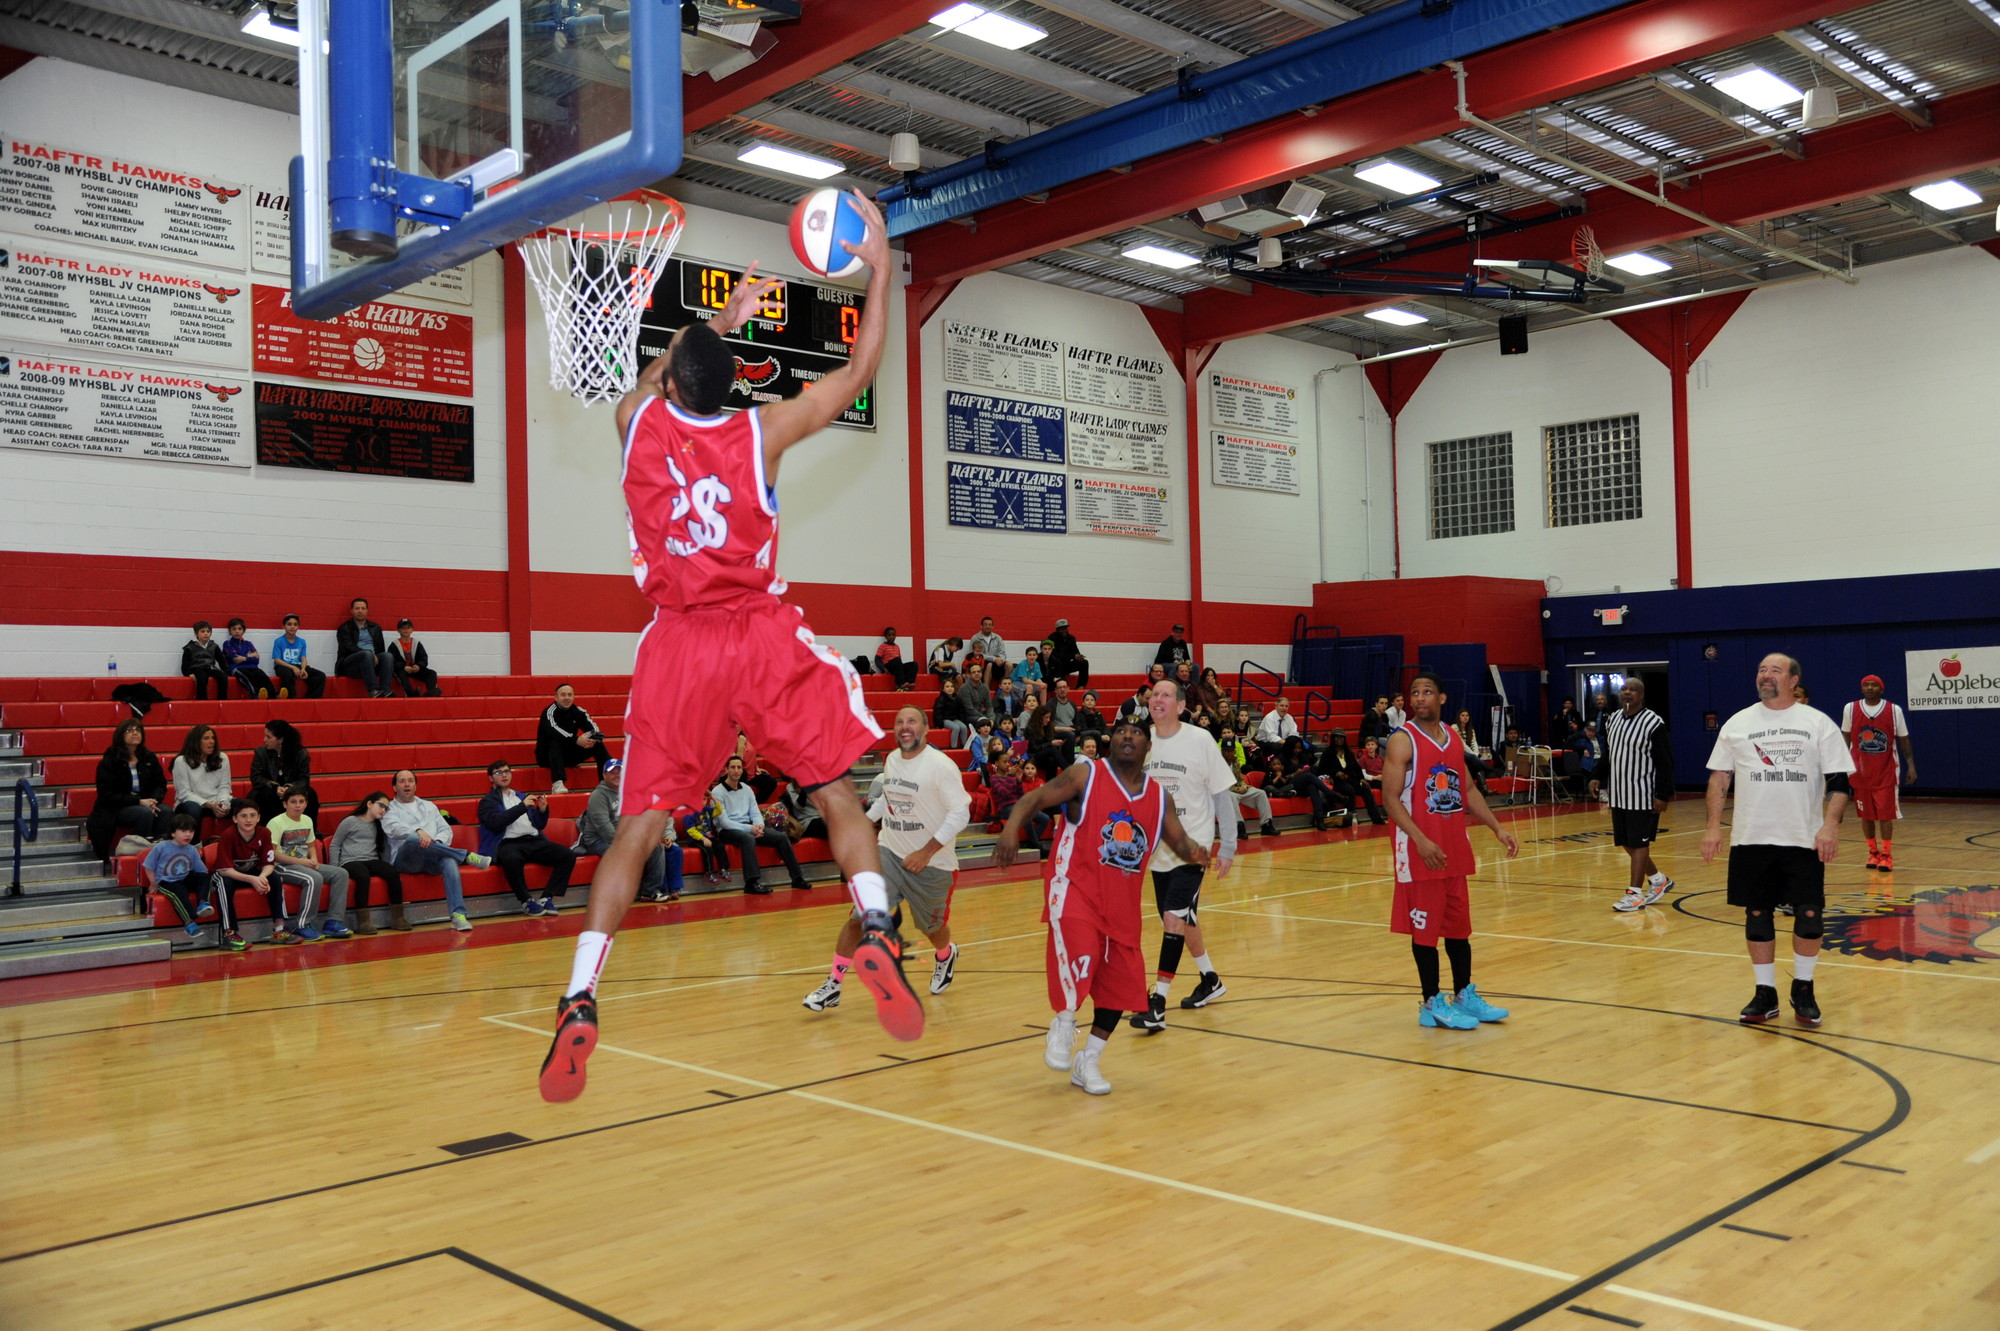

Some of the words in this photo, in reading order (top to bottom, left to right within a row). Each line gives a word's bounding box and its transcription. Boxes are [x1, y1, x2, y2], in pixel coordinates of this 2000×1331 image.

[12, 142, 102, 169] HAFTR
[112, 161, 202, 189] HAWKS
[12, 155, 60, 173] 2007-08
[64, 165, 113, 183] MYHSBL
[117, 176, 131, 186] JV
[135, 179, 201, 200] CHAMPIONS
[80, 183, 104, 193] DOVIE
[106, 188, 138, 199] GROSSER
[81, 192, 109, 202] SHAWN
[111, 197, 137, 207] ISRAELI
[86, 201, 105, 211] YONI
[107, 205, 132, 215] KAMEL
[164, 207, 190, 217] SHELBY
[191, 212, 231, 225] ROSENBERG
[174, 201, 199, 210] SAMMY
[200, 206, 222, 215] MYERS
[74, 208, 93, 217] YONI
[95, 212, 144, 226] KESTENBAUM
[170, 217, 201, 228] MICHAEL
[203, 223, 225, 232] SCHIFF
[82, 218, 99, 227] MAX
[101, 222, 136, 233] KURITZKY
[168, 225, 189, 234] ADAM
[191, 229, 227, 241] SCHWARTZ
[34, 223, 72, 235] COACHES:
[74, 230, 107, 241] MICHAEL
[138, 241, 158, 249] EVAN
[160, 244, 198, 256] SCHARAGA
[160, 233, 199, 244] JONATHAN
[200, 239, 235, 250] SHAMAMA
[16, 252, 79, 270] HAFTR
[86, 263, 132, 277] LADY
[139, 271, 202, 289] HAWKS
[17, 264, 63, 280] 2007-08
[67, 272, 115, 288] MYHSBL
[119, 280, 133, 290] JV
[136, 283, 201, 300] CHAMPIONS
[89, 289, 126, 300] DANIELLA
[127, 295, 150, 303] LAZAR
[817, 288, 854, 306] GUESTS
[173, 302, 206, 312] DANIELLE
[208, 307, 231, 315] MILLER
[696, 311, 712, 320] POSS
[170, 310, 202, 319] JORDANA
[204, 314, 234, 324] POLLACK
[366, 304, 448, 331] HAWKS
[347, 320, 370, 331] 2001
[372, 323, 420, 337] CHAMPIONS
[759, 322, 774, 331] POSS
[60, 327, 81, 335] HEAD
[83, 330, 111, 339] COACH:
[113, 334, 135, 343] RENEE
[137, 338, 179, 348] GREENSPAN
[979, 341, 994, 349] 2003
[1004, 332, 1059, 352] FLAMES
[68, 337, 104, 346] ASSISTANT
[106, 341, 133, 350] COACH:
[135, 345, 153, 353] TARA
[155, 348, 172, 356] RATZ
[824, 342, 848, 354] BONUS
[1068, 347, 1112, 365] HAFTR
[1117, 355, 1164, 374] FLAMES
[18, 359, 80, 375] HAFTR
[87, 368, 133, 380] LADY
[140, 374, 203, 389] HAWKS
[20, 371, 65, 386] 2008-09
[69, 377, 116, 391] MYHSBL
[120, 383, 133, 393] JV
[137, 385, 201, 401] CHAMPIONS
[1222, 376, 1250, 387] HAFTR
[1253, 382, 1285, 393] FLAMES
[260, 385, 308, 407] HAFTR
[309, 390, 365, 413] VARSITY
[370, 396, 403, 417] BOYS
[406, 400, 469, 423] SOFTBALL
[950, 393, 992, 411] HAFTR
[994, 399, 1012, 413] JV
[1014, 401, 1062, 420] FLAMES
[844, 410, 866, 422] FOULS
[1070, 411, 1104, 427] HAFTR
[1106, 416, 1130, 430] LADY
[1132, 419, 1168, 435] FLAMES
[379, 419, 441, 433] CHAMPIONS
[10, 437, 49, 446] ASSISTANT
[51, 441, 80, 449] COACH:
[83, 443, 102, 451] TARA
[104, 445, 122, 453] RATZ
[27, 430, 58, 438] COACH:
[59, 433, 83, 441] RENEE
[85, 435, 129, 445] GREENSPAN
[1227, 436, 1253, 445] HAFTR
[1257, 441, 1288, 450] FLAMES
[189, 444, 221, 453] FRIEDMAN
[951, 464, 994, 480] HAFTR
[996, 469, 1014, 482] JV
[1016, 471, 1063, 487] FLAMES
[1085, 480, 1117, 489] HAFTR
[1120, 484, 1156, 493] FLAMES
[1606, 610, 1618, 620] EXIT
[1910, 696, 1964, 706] SUPPORTING
[1966, 696, 1984, 704] OUR
[1780, 728, 1810, 739] Community
[1160, 761, 1187, 774] Community
[1750, 771, 1762, 781] Five
[1763, 770, 1783, 781] Towns
[267, 850, 274, 862] 3
[1410, 908, 1428, 930] 45
